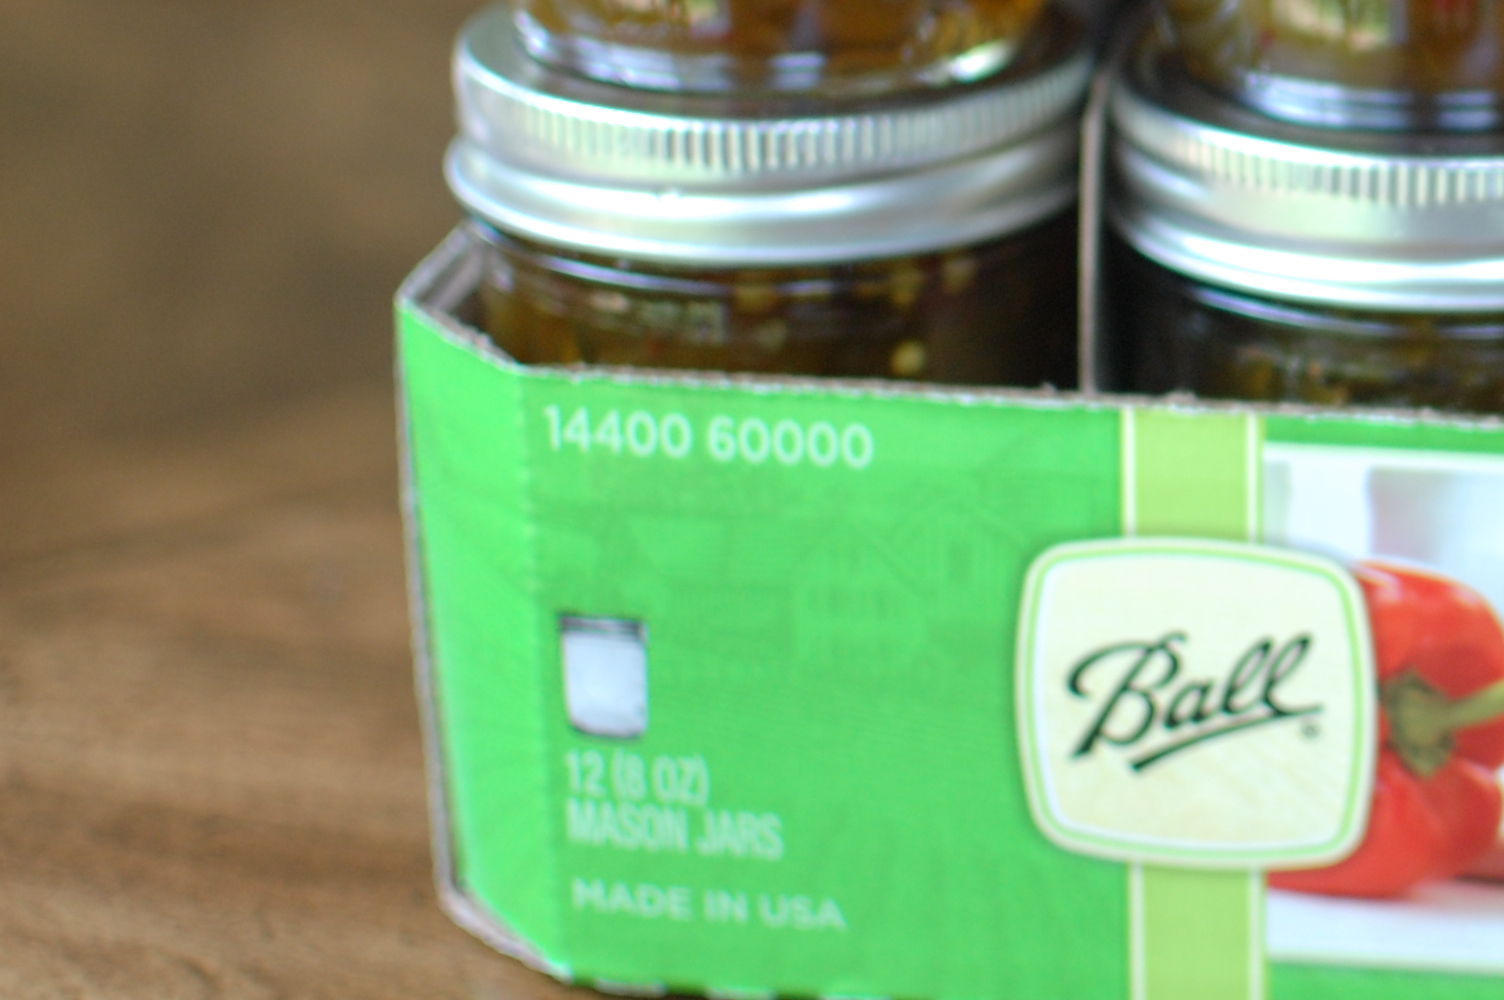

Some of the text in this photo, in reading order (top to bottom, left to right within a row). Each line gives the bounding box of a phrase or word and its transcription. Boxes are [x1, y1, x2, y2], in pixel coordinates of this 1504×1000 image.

[544, 405, 874, 468] 14400 60000
[1066, 628, 1322, 774] Ball
[565, 750, 607, 796] 12
[652, 753, 711, 806] OZ)
[566, 798, 786, 861] MASON JARS
[571, 876, 848, 931] MADE IN USA
